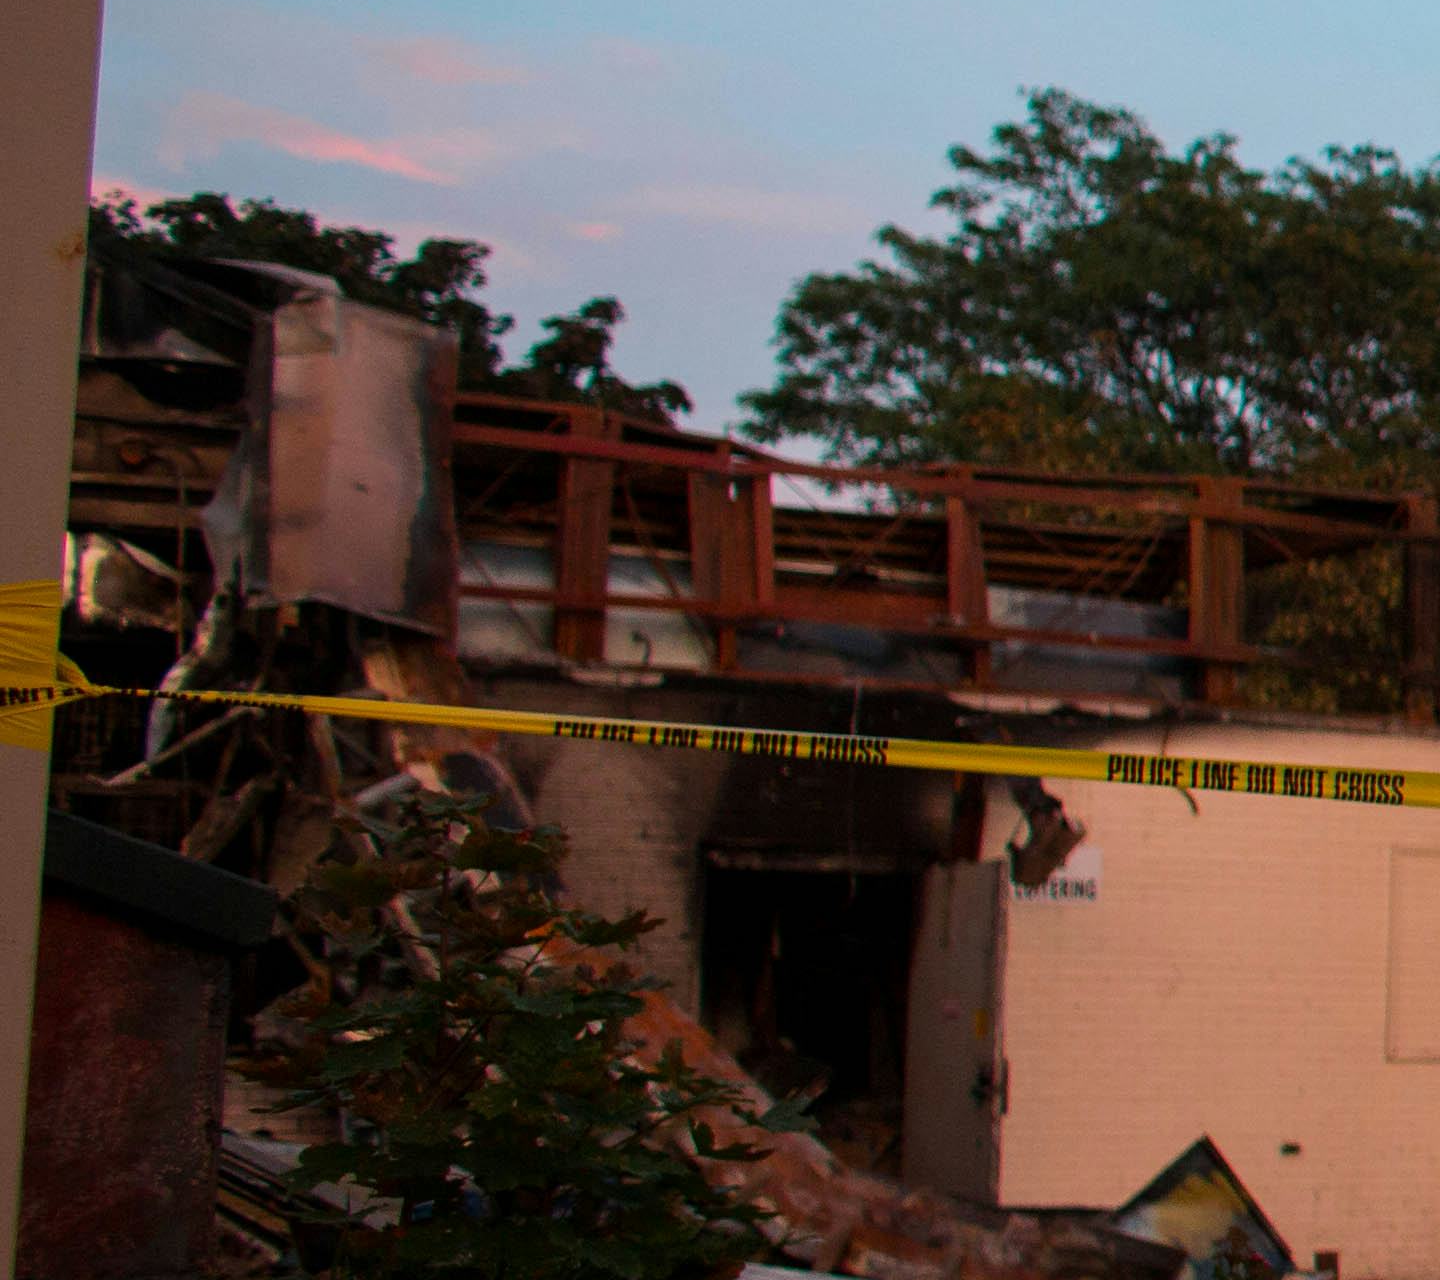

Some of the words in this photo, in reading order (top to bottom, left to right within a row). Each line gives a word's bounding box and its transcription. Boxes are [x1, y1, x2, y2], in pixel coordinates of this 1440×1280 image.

[1107, 753, 1184, 786] POLICE
[1190, 760, 1240, 791] LINE
[1247, 764, 1276, 795] DO
[1283, 767, 1328, 799] NOT
[1333, 771, 1405, 806] CROSS
